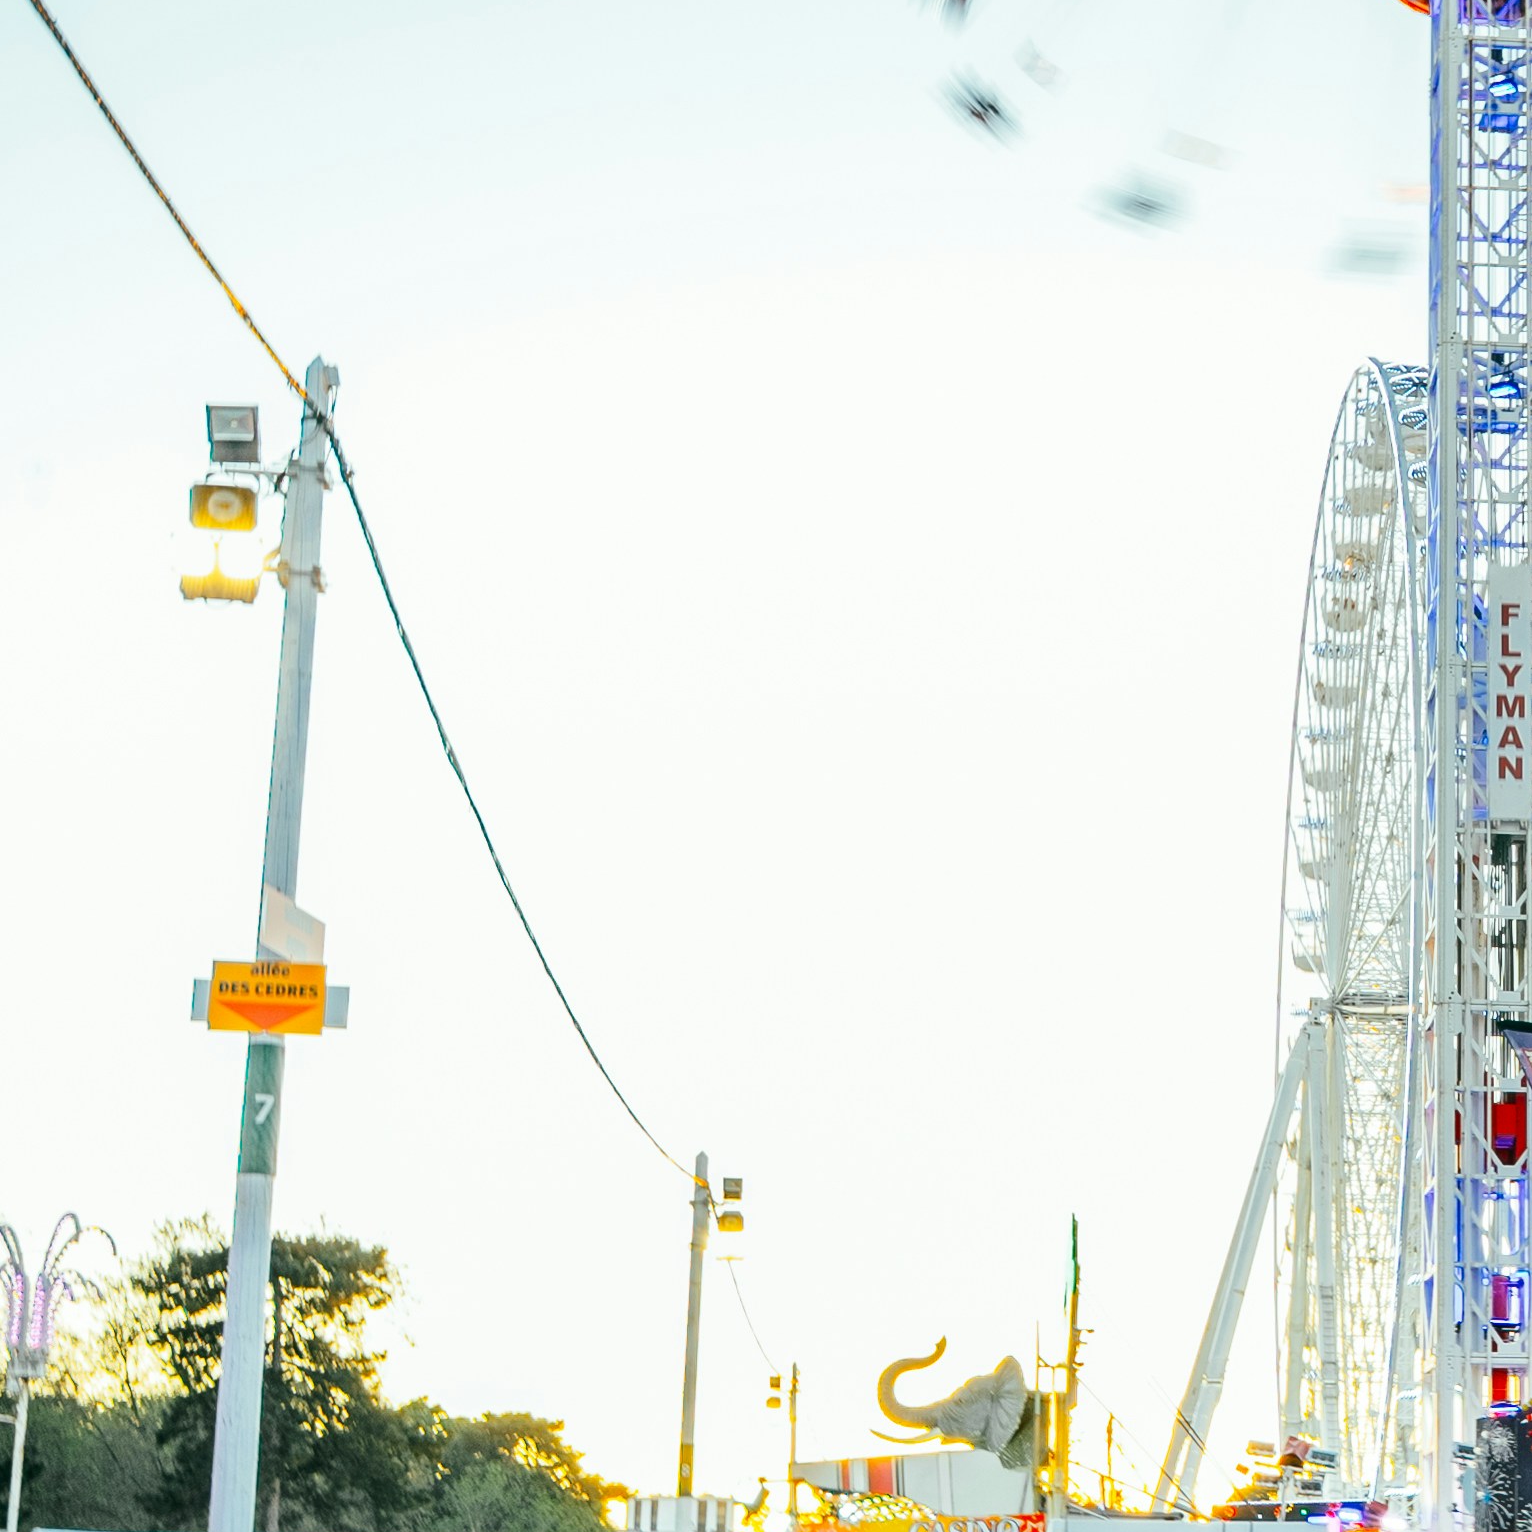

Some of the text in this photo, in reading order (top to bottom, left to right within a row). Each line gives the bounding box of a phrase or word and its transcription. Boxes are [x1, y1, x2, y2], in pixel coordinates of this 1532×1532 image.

[1496, 603, 1526, 780] FLYMAN
[251, 964, 290, 977] allée
[219, 981, 318, 998] DES CEDRES
[255, 1093, 275, 1125] 7
